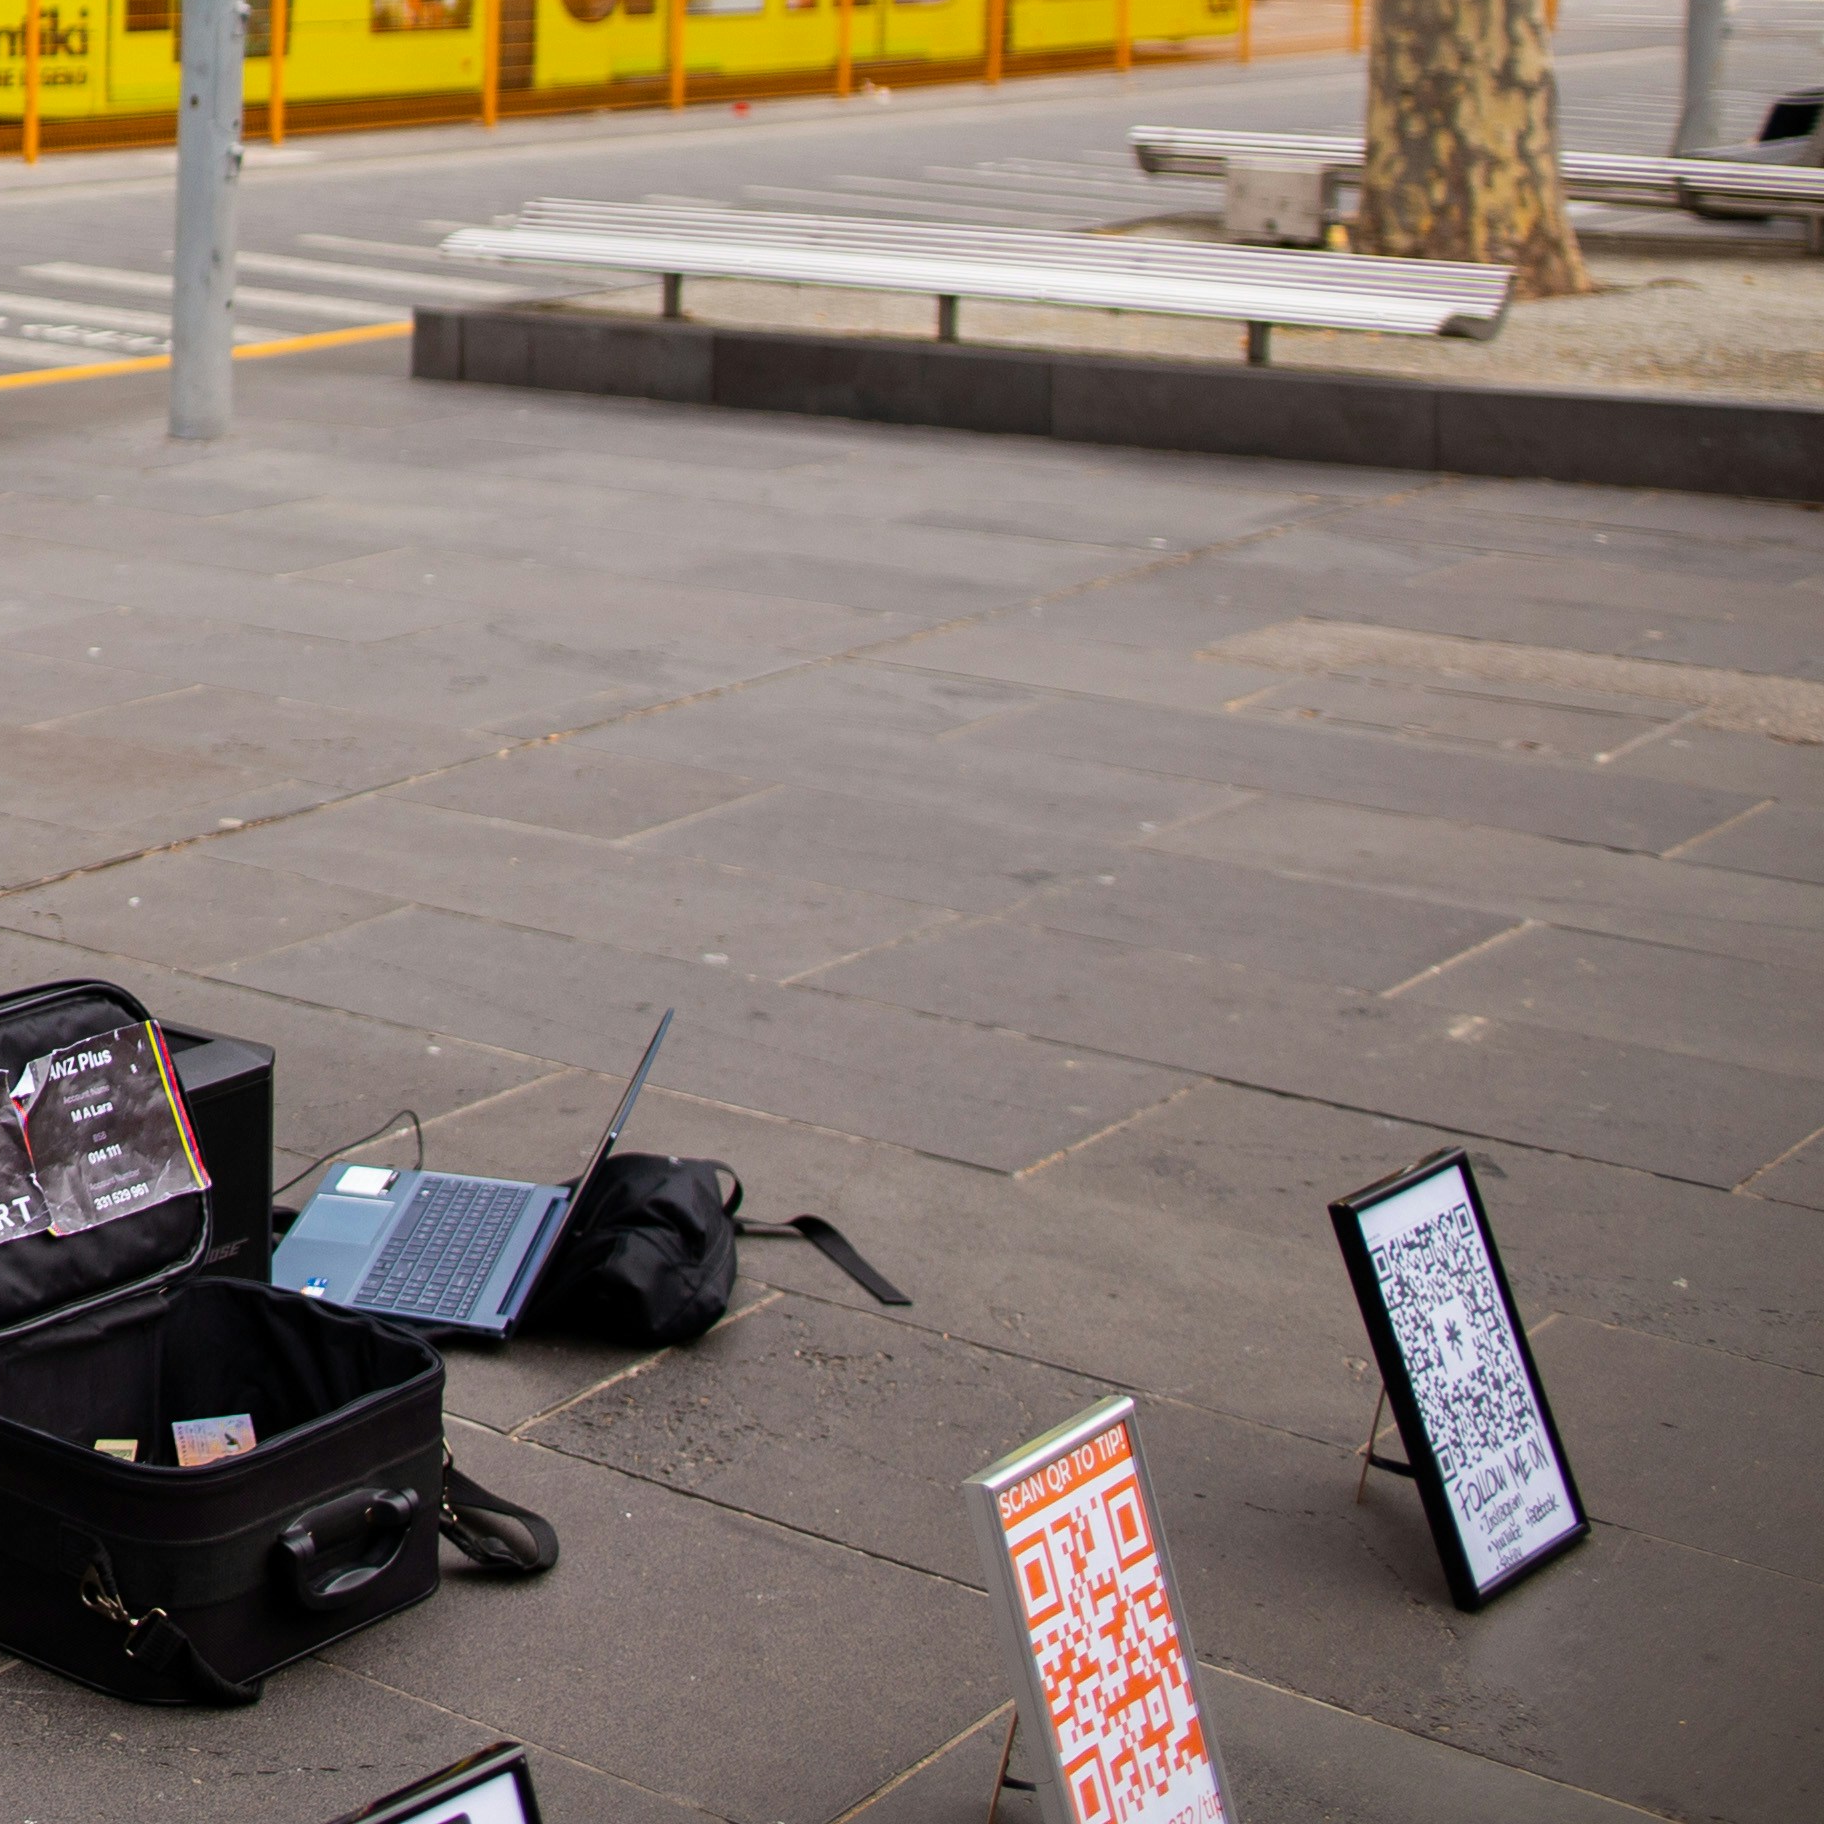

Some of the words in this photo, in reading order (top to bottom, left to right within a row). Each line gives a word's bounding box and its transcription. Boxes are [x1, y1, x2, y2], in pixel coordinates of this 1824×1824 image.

[49, 1056, 80, 1082] ANZ
[78, 1049, 112, 1071] Plus
[63, 1088, 92, 1104] Account
[70, 1110, 83, 1123] M
[91, 1101, 113, 1118] Lara
[208, 1237, 250, 1264] OSE
[999, 1472, 1046, 1519] SCAN
[1046, 1457, 1073, 1493] QR
[1071, 1444, 1095, 1476] TO
[1094, 1425, 1126, 1461] TIP!
[1454, 1464, 1509, 1522] FOLLOW
[1504, 1444, 1532, 1490] ME
[1527, 1429, 1550, 1470] ON
